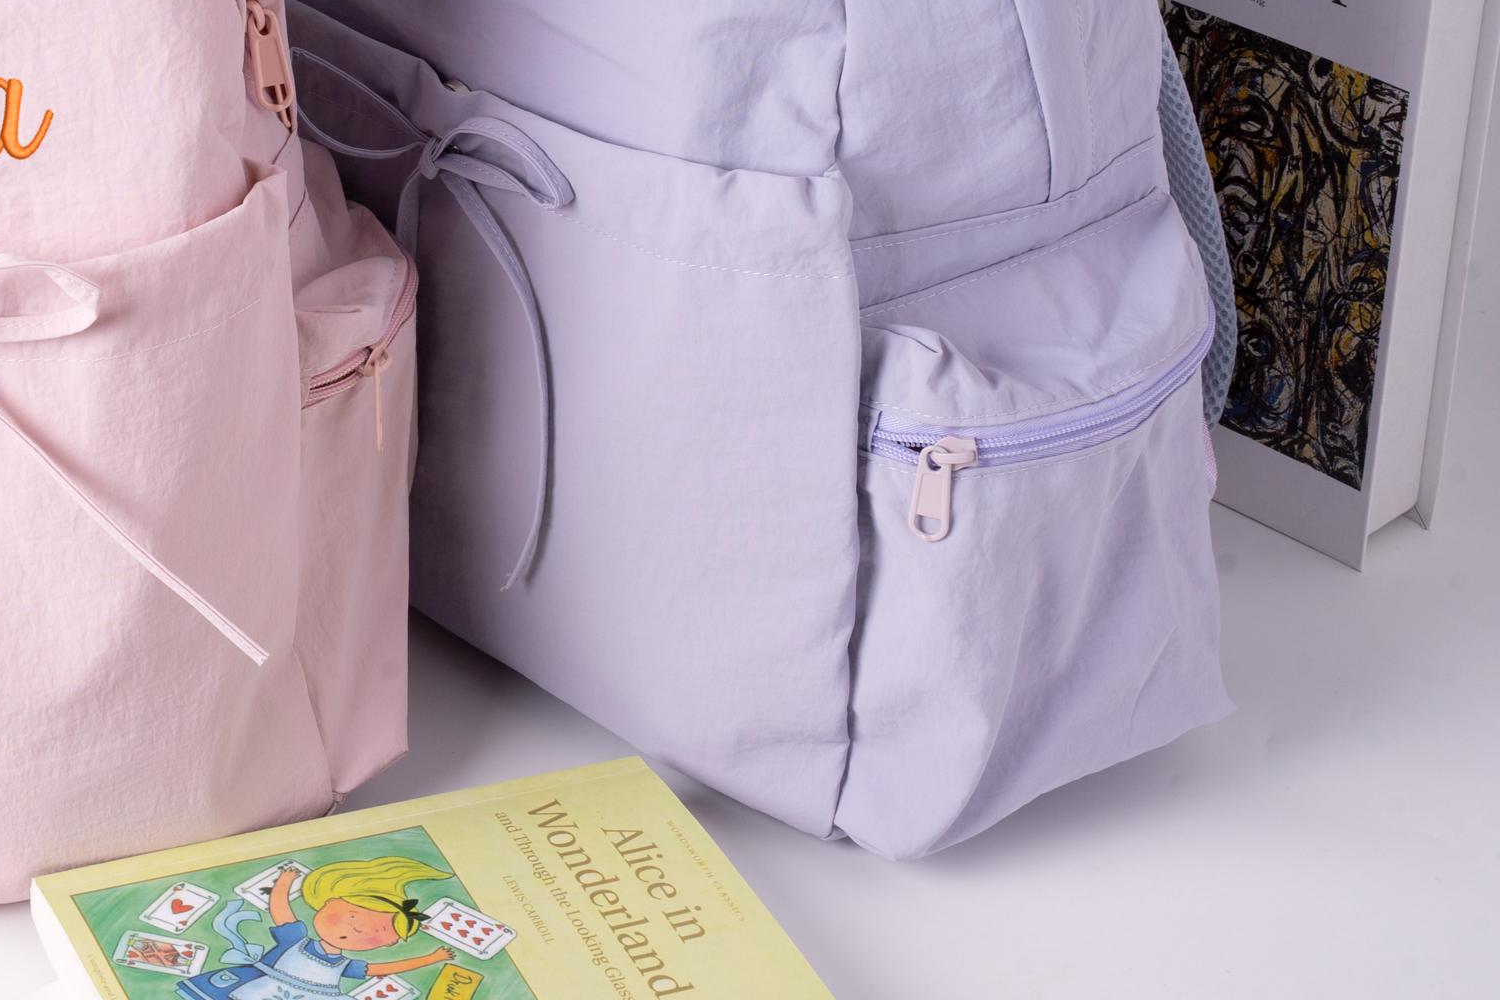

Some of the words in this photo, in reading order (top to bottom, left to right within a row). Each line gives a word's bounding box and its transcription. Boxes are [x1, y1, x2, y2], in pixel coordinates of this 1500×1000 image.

[495, 811, 521, 834] and
[513, 829, 557, 888] Through
[550, 882, 574, 910] the
[565, 908, 610, 967] Looking
[502, 875, 526, 905] LEWIS
[522, 901, 555, 944] CARROLL
[527, 799, 695, 1000] Wonderland
[600, 826, 677, 900] Alice
[662, 905, 706, 944] in
